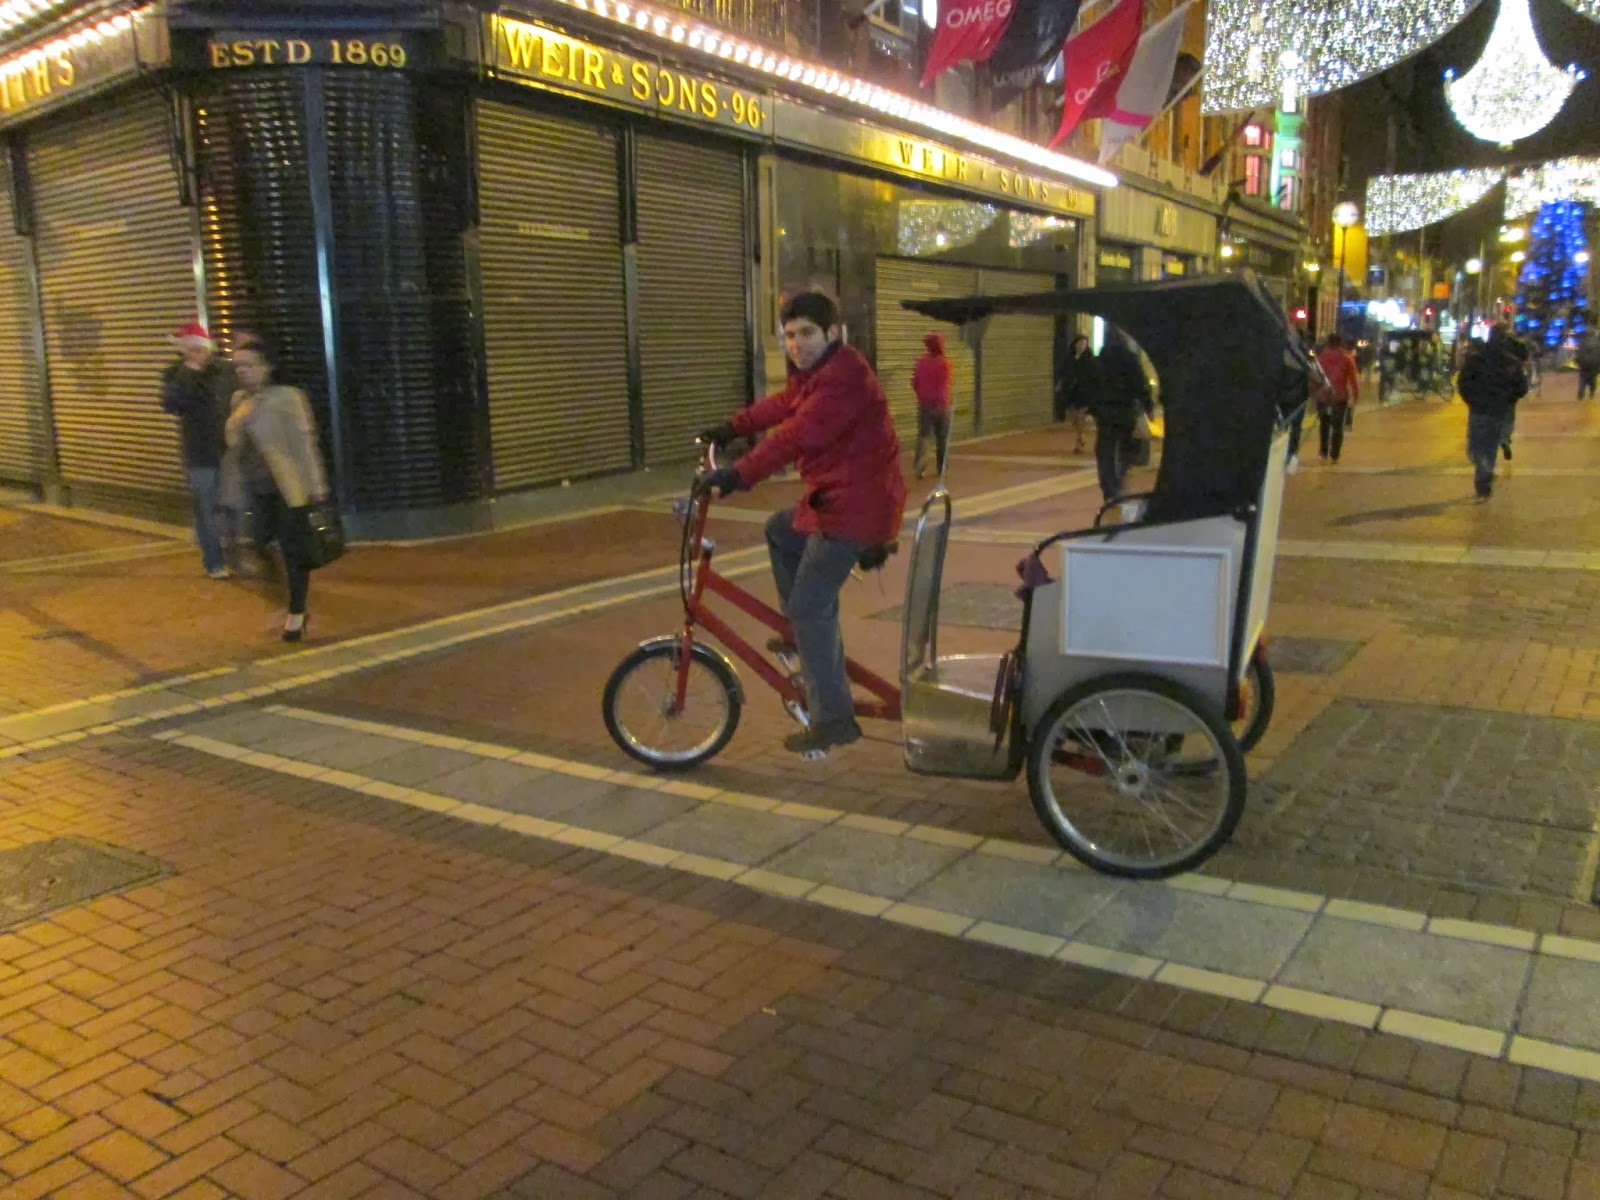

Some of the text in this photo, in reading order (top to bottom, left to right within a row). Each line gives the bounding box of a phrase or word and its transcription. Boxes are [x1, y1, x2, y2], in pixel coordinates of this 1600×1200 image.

[330, 39, 407, 68] 1869
[503, 25, 606, 90] WEIR
[611, 62, 624, 86] &
[631, 60, 719, 119] SONS
[899, 140, 969, 181] WEIR
[999, 171, 1049, 203] SONS
